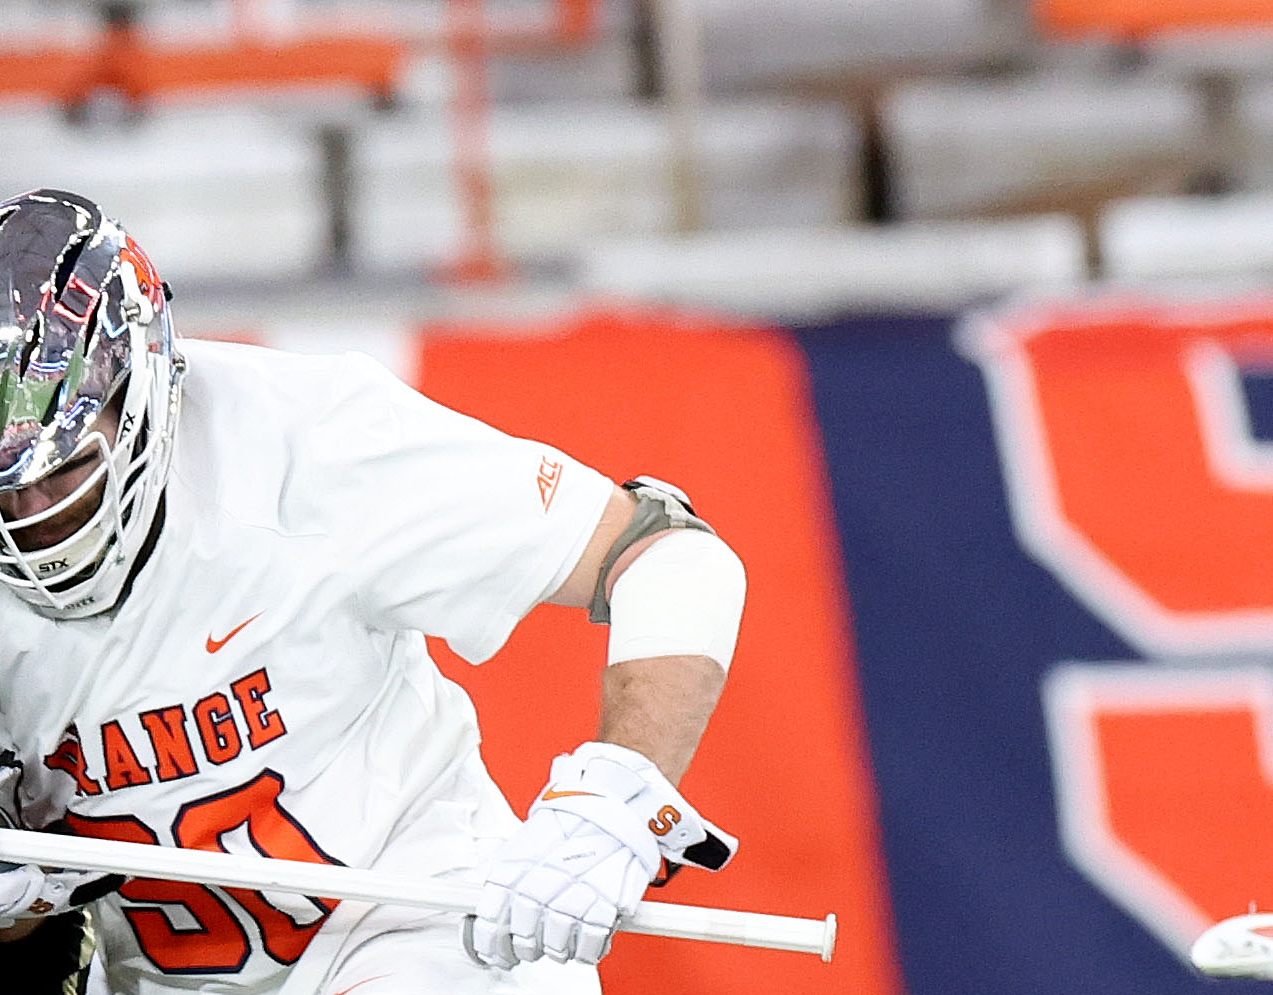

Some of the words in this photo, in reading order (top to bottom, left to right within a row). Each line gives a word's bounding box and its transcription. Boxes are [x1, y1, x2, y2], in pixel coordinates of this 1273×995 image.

[537, 455, 557, 506] ACC
[38, 558, 69, 573] STX
[43, 667, 287, 796] RANGE
[648, 804, 682, 837] S
